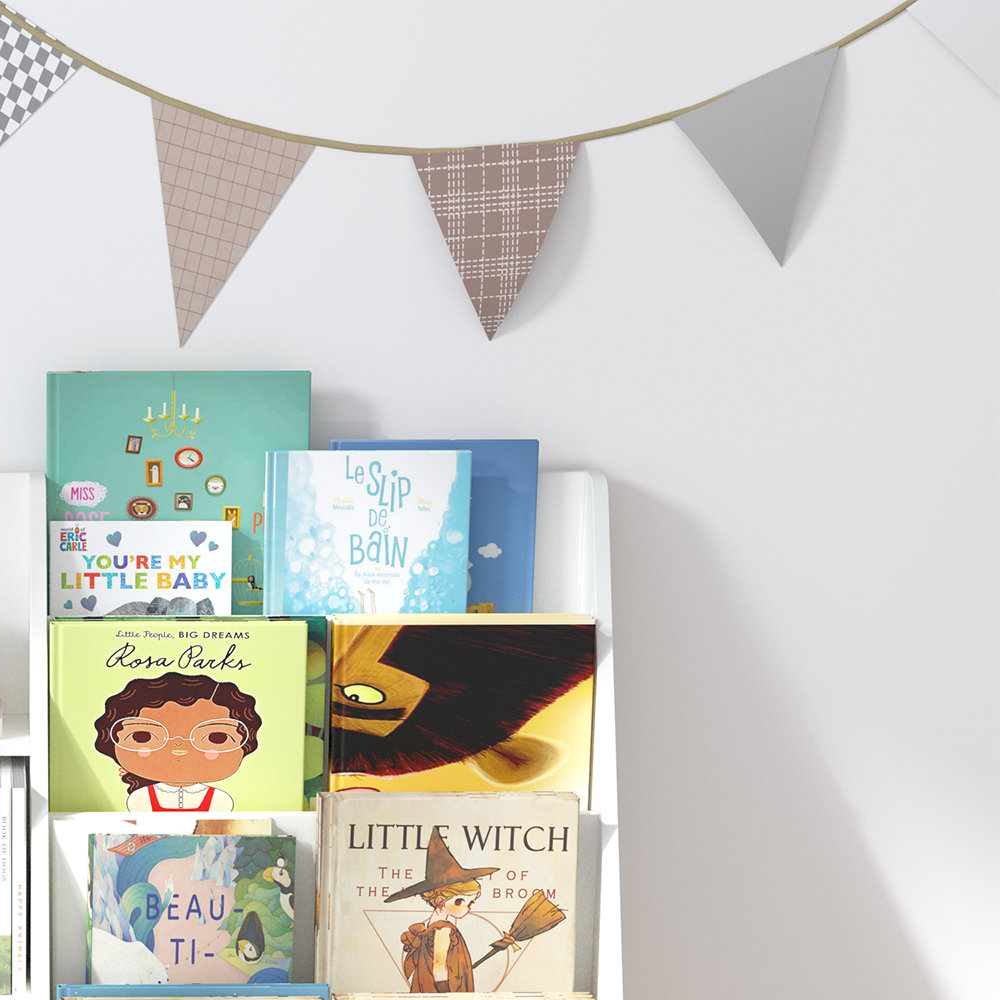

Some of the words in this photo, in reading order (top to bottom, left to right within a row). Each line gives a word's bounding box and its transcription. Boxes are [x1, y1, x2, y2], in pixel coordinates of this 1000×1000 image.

[70, 487, 95, 501] MISS
[59, 542, 87, 552] CARLE
[82, 555, 162, 570] YOU'RE
[169, 555, 202, 570] MY
[61, 572, 148, 590] LITTLE
[156, 572, 227, 590] BABY
[115, 629, 141, 639] Little
[178, 631, 199, 639] BIG
[203, 631, 250, 640] DREAMS
[106, 642, 175, 669] Rosa
[177, 643, 252, 671] Parks
[348, 824, 450, 850] LITTLE
[462, 825, 570, 852] WITCH
[378, 866, 413, 880] THE
[506, 870, 529, 881] OF
[356, 886, 389, 898] THE
[146, 893, 244, 921] BEAU-
[170, 938, 215, 965] TI-
